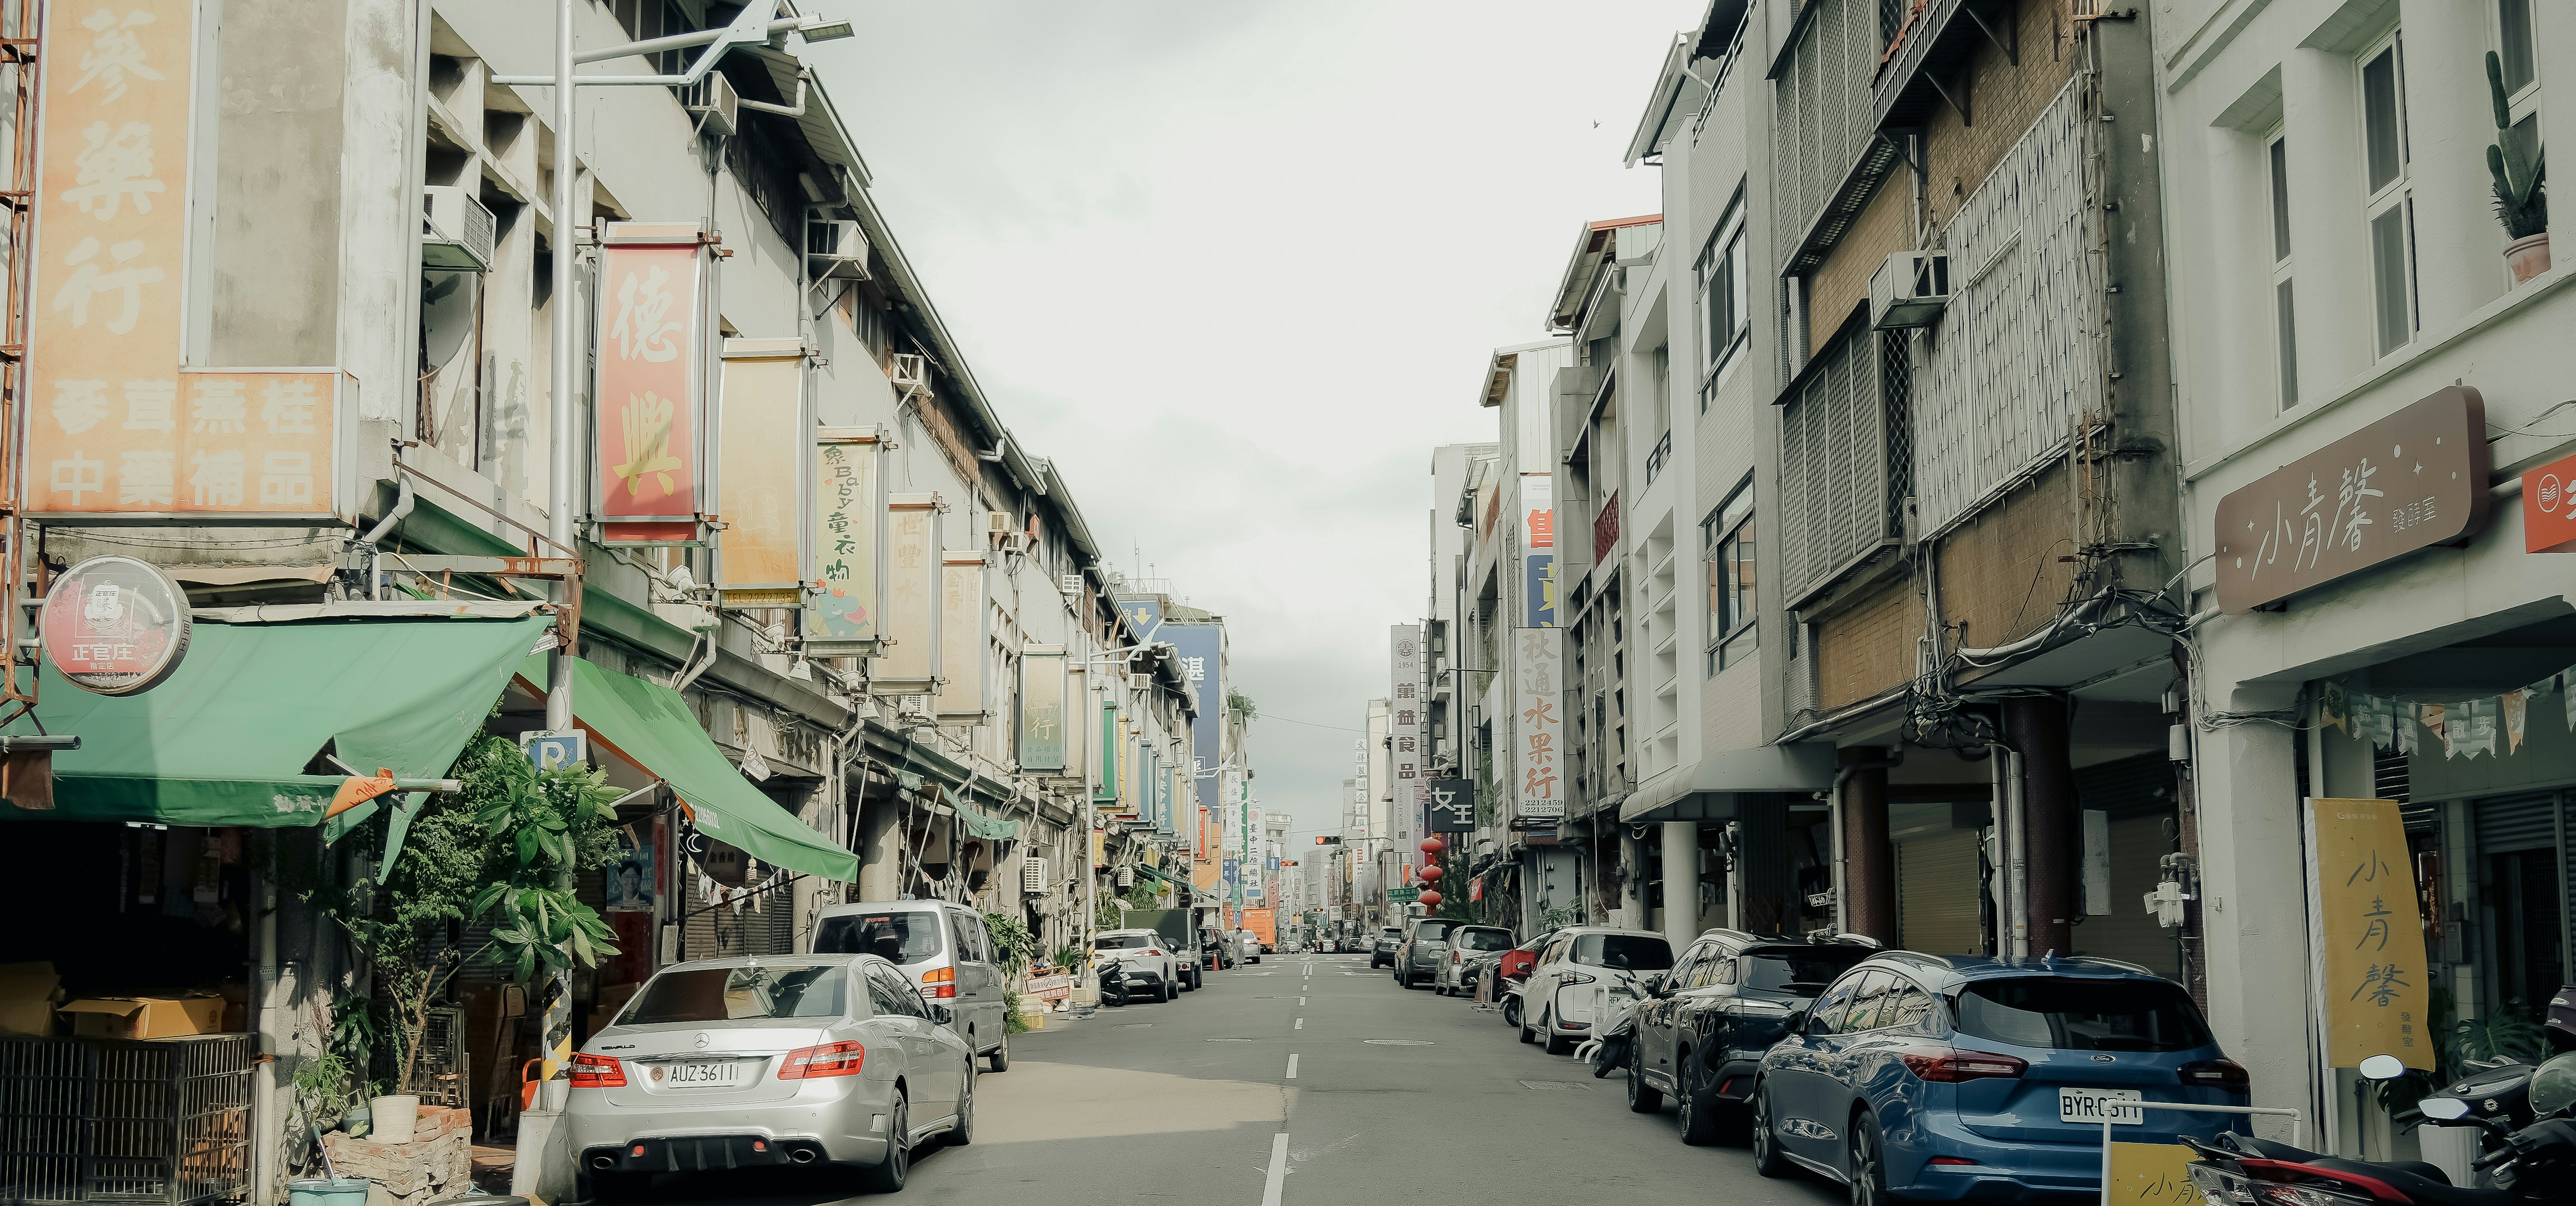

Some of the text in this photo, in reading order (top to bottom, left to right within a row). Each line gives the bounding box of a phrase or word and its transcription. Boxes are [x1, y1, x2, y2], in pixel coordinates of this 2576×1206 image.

[50, 450, 314, 508] 中藥補品
[2251, 457, 2384, 582] 小青馨
[2391, 495, 2437, 534] 發酵室
[71, 642, 135, 661] 正官庄
[89, 662, 115, 670] 指定店
[1397, 682, 1416, 780] 萬益食品
[1431, 786, 1474, 825] 女王
[2347, 849, 2411, 1007] 小青馨
